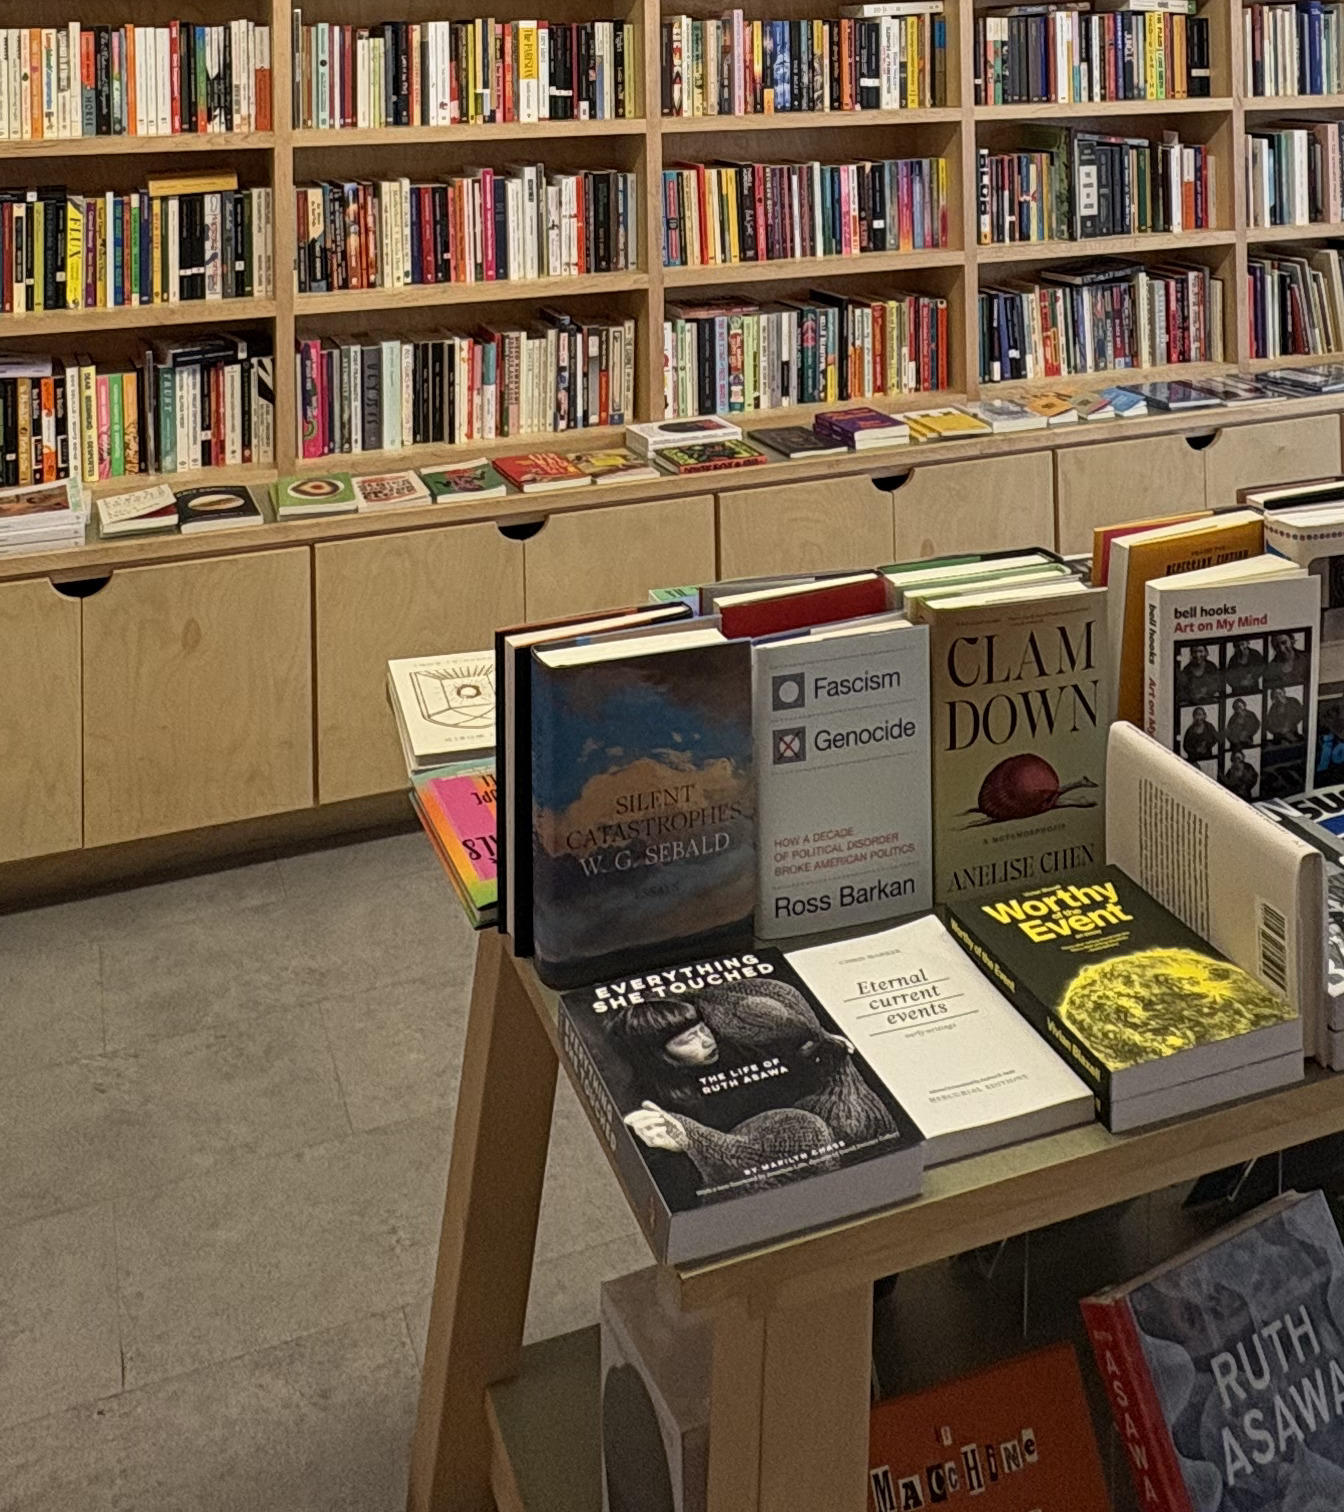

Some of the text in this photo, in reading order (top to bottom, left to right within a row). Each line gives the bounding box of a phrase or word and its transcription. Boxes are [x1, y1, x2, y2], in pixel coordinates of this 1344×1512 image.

[85, 96, 94, 127] HORSE
[69, 216, 81, 260] FLUX
[1174, 604, 1237, 620] bell hooks
[1174, 614, 1268, 634] Art on My Mind
[948, 620, 1096, 688] CLAM
[814, 670, 900, 699] Fascism
[944, 680, 1099, 752] DOWN
[814, 718, 916, 752] Genocide
[615, 784, 697, 816] SILENT
[566, 800, 743, 851] CATASTROPHES
[774, 827, 854, 849] HOW A DECADE
[579, 832, 731, 878] W. G. SEBALD
[774, 832, 899, 863] OF POLITICAL DISORDER
[774, 843, 916, 877] BROKE AMERICAN POLITICS
[947, 843, 1095, 894] ANELISE CHEN
[775, 878, 916, 919] Ross Barkan
[981, 882, 1119, 925] Worthy
[1018, 903, 1134, 943] Event
[592, 963, 775, 1014] SHE TOUCHED
[594, 954, 761, 1000] EVERYTHING
[856, 968, 929, 996] Eternal
[869, 984, 942, 1011] current
[887, 1001, 949, 1025] events
[699, 1057, 781, 1087] THE LIFE OF
[702, 1065, 789, 1096] RUTH ASAWA
[761, 1153, 809, 1170] MARILYN
[1209, 1304, 1321, 1410] RUTH
